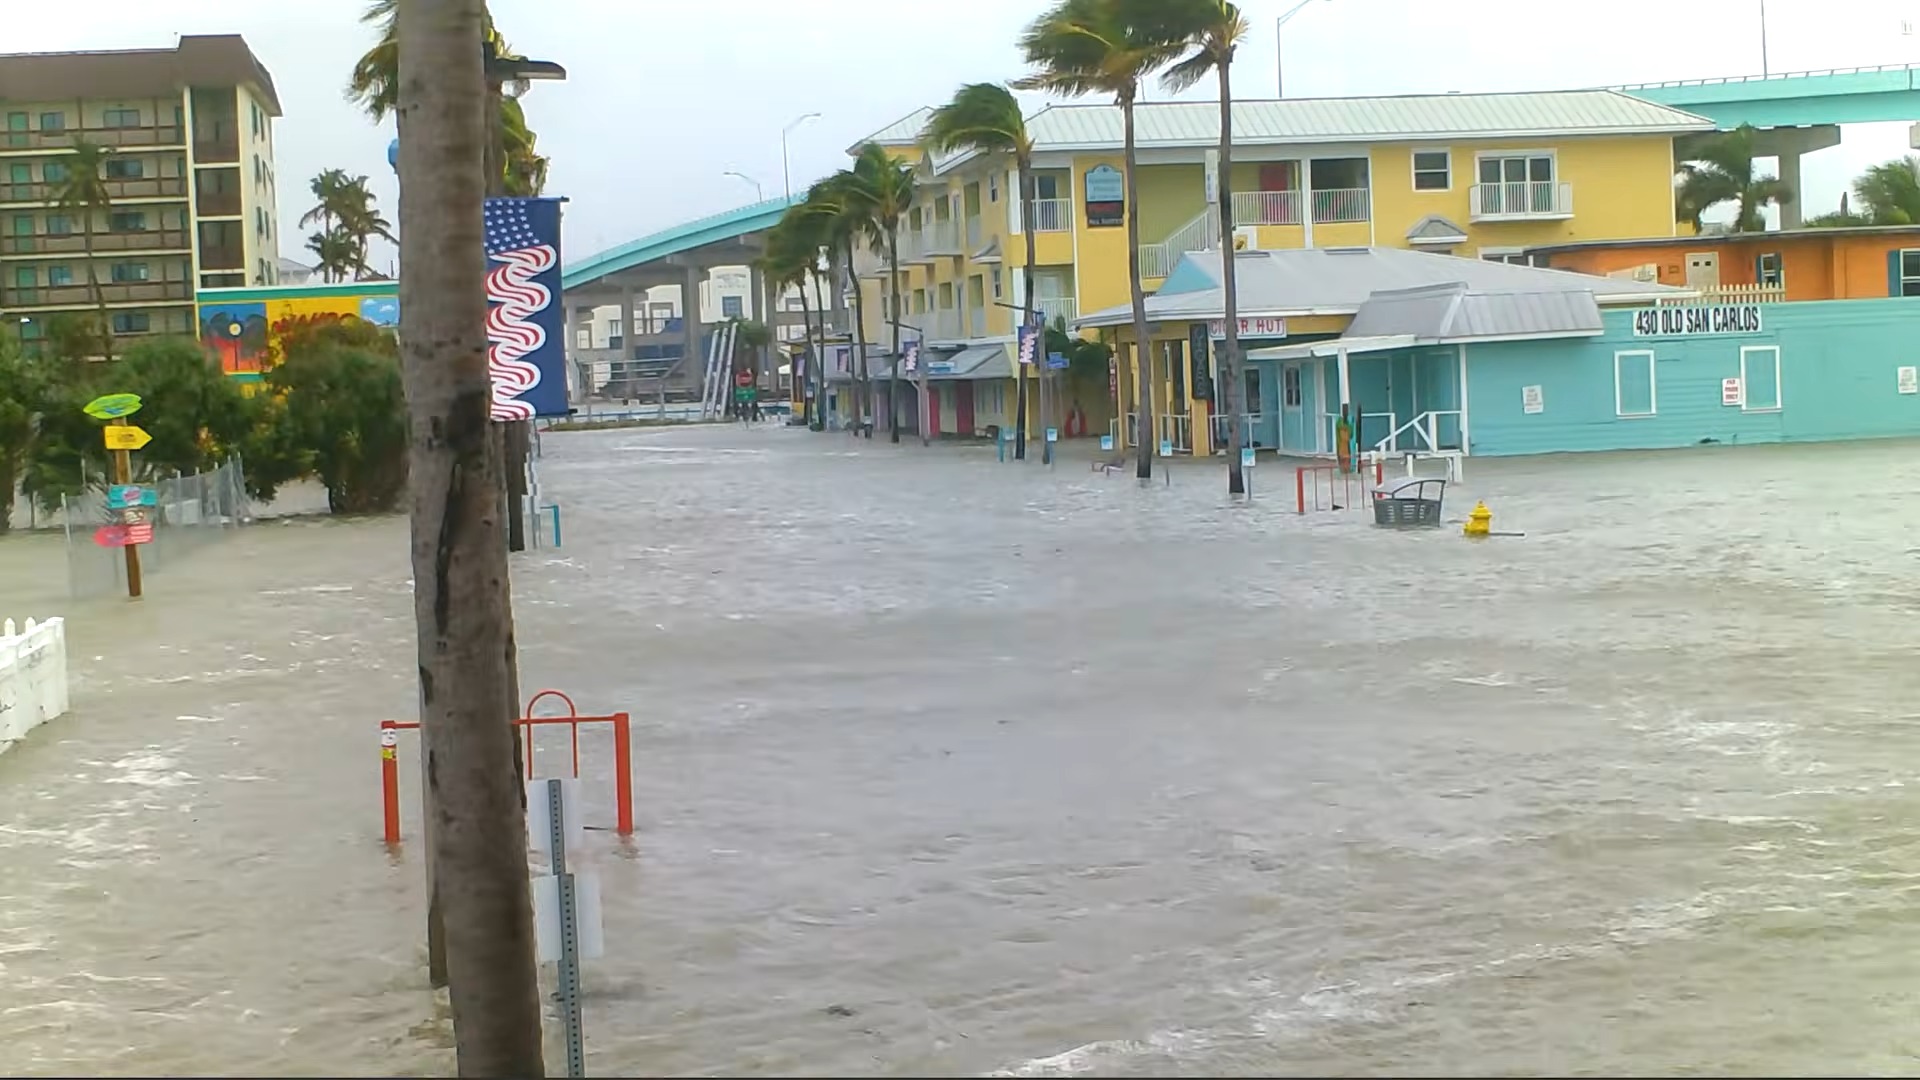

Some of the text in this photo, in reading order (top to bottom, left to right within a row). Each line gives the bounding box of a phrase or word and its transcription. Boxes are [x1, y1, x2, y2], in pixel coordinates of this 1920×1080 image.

[1211, 318, 1284, 336] CIR HUT
[1636, 306, 1759, 335] 430 OLD SAN CARLOS
